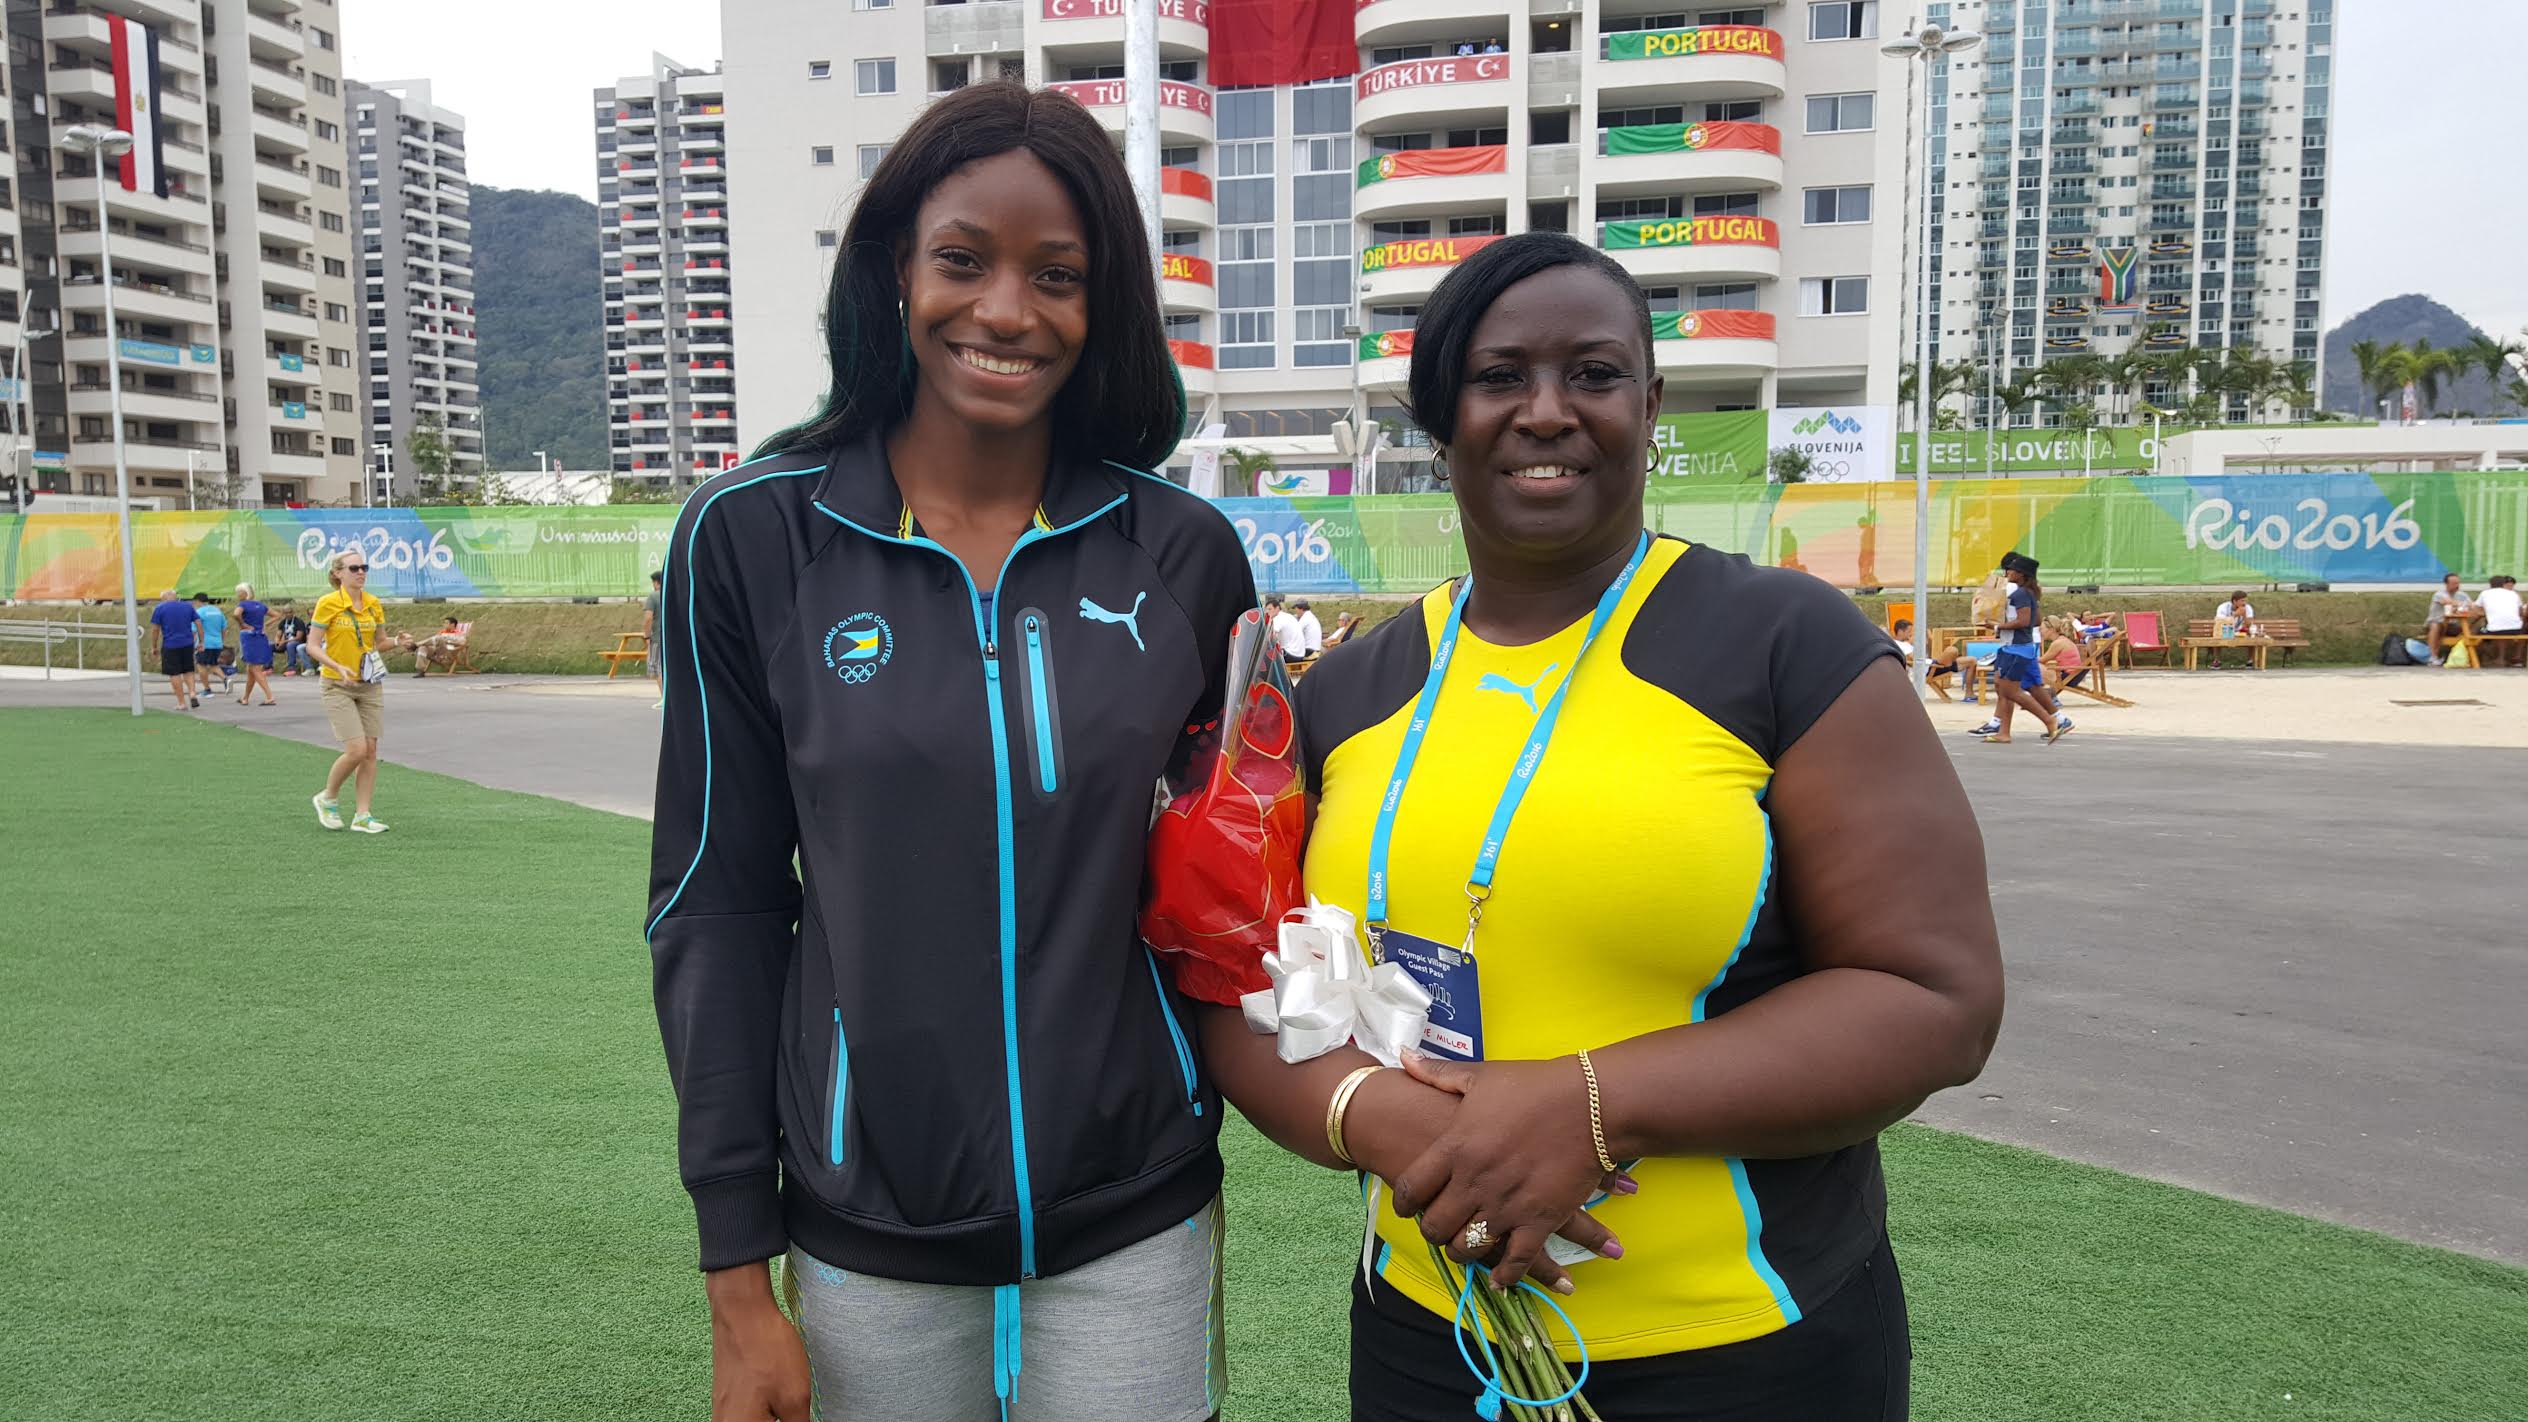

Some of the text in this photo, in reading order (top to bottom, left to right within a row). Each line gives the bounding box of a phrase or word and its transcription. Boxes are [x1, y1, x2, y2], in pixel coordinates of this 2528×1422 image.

[1644, 29, 1772, 57] PORTUGAL
[1364, 63, 1456, 95] TÜRKİYE
[1095, 81, 1188, 107] TÜYE
[1639, 218, 1766, 245] PORTUGAL
[1362, 241, 1461, 270] ORTUGAL
[1789, 441, 1864, 454] SLOVENIJA
[1900, 443, 1910, 464] I
[1928, 442, 1977, 464] EEL
[1985, 439, 2116, 462] SLOVENIA
[2185, 497, 2421, 551] Rio2016
[1235, 518, 1332, 564] 2016
[823, 612, 894, 668] BAHAMAS OLYMPIC COMMITTEE
[1517, 740, 1543, 779] Rio2016
[1397, 948, 1451, 972] Olympic Village
[1408, 960, 1445, 979] Guest Pass
[1436, 1033, 1469, 1050] MILLER
